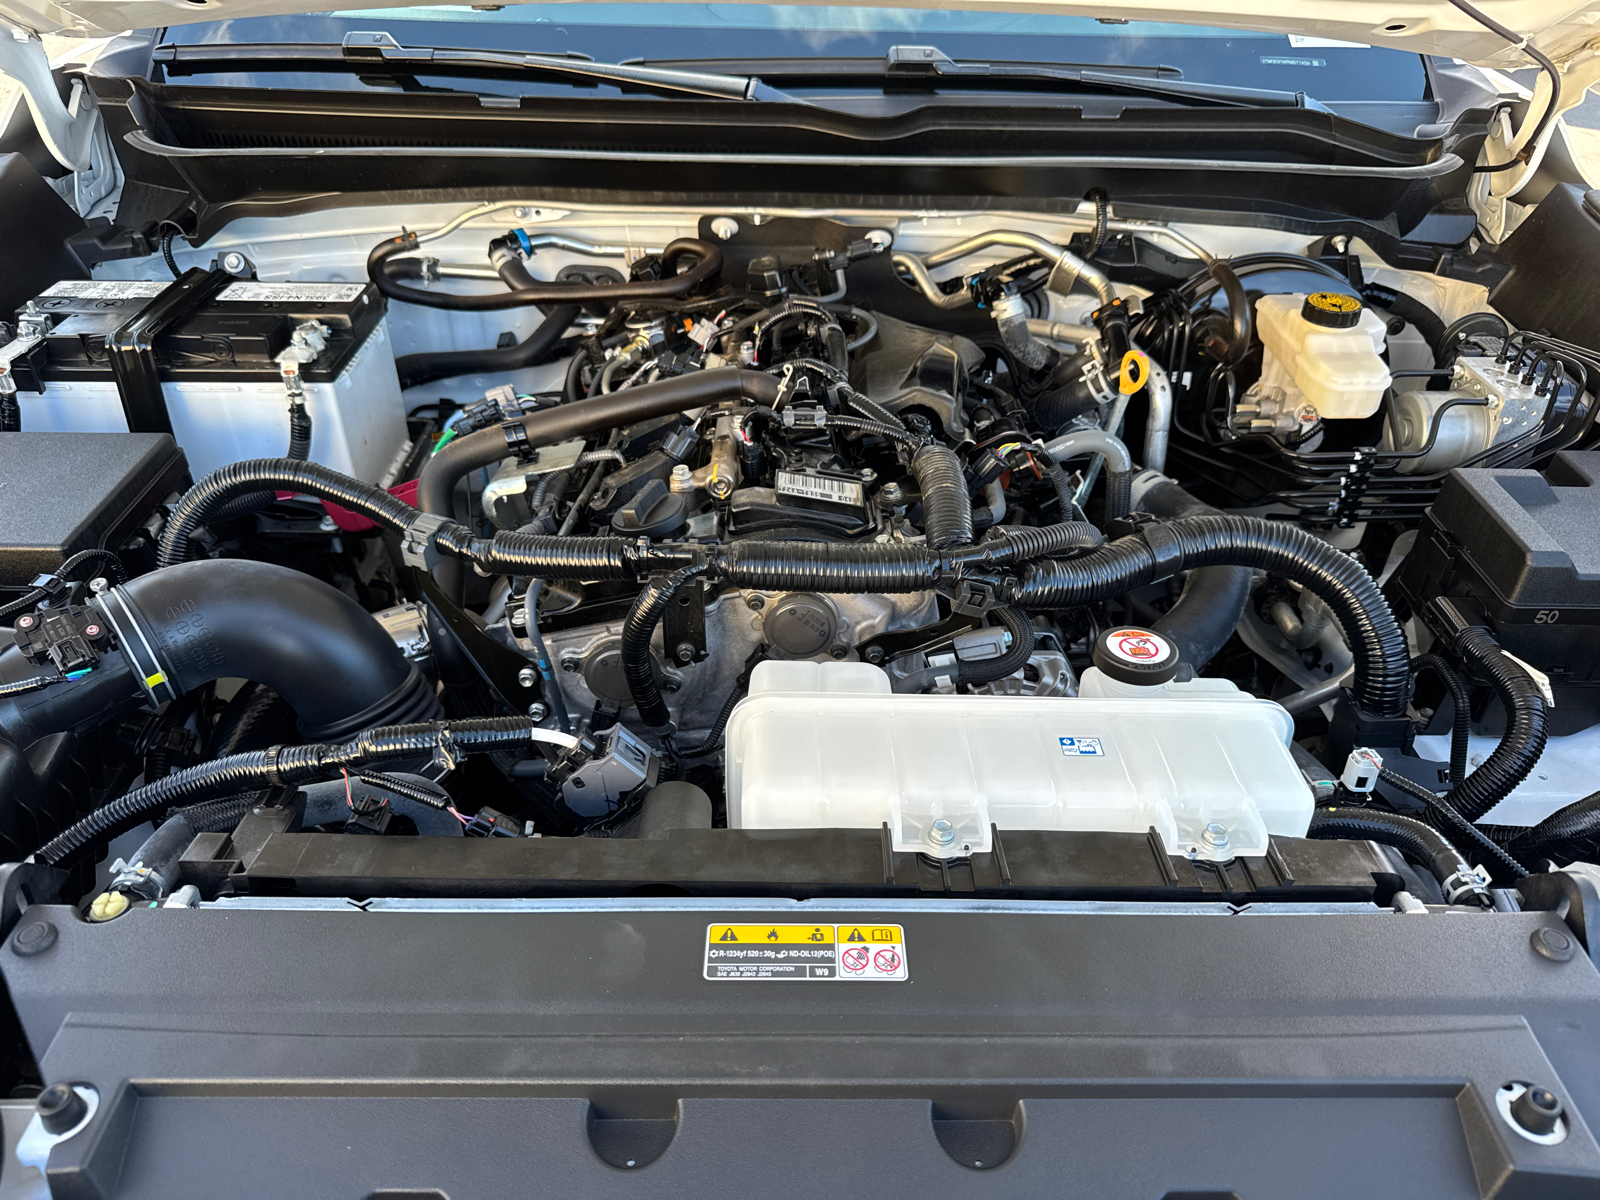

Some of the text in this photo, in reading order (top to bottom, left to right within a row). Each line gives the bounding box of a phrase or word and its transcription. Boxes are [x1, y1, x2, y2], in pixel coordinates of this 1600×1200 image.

[1533, 610, 1560, 624] 50
[719, 950, 835, 959] R-1234yf 520±30g ND-OIL12(POE)
[814, 968, 829, 976] W9
